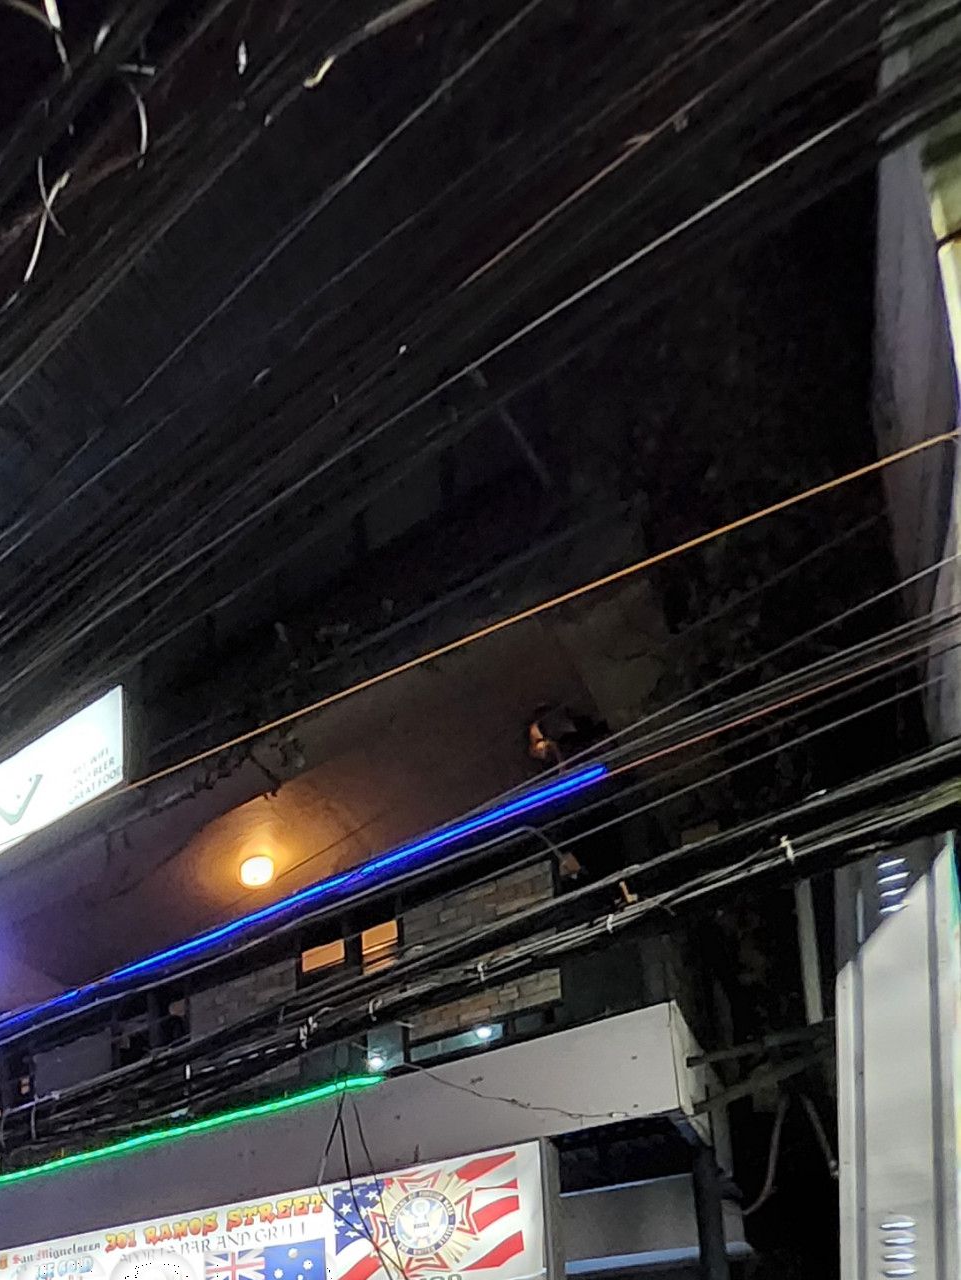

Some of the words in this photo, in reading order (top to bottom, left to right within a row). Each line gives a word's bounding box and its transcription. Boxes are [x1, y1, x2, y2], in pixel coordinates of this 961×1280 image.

[105, 1229, 137, 1254] 301
[143, 1211, 220, 1246] RAMOS
[225, 1192, 327, 1232] STREET
[181, 1238, 212, 1256] BAR
[216, 1230, 251, 1249] AND
